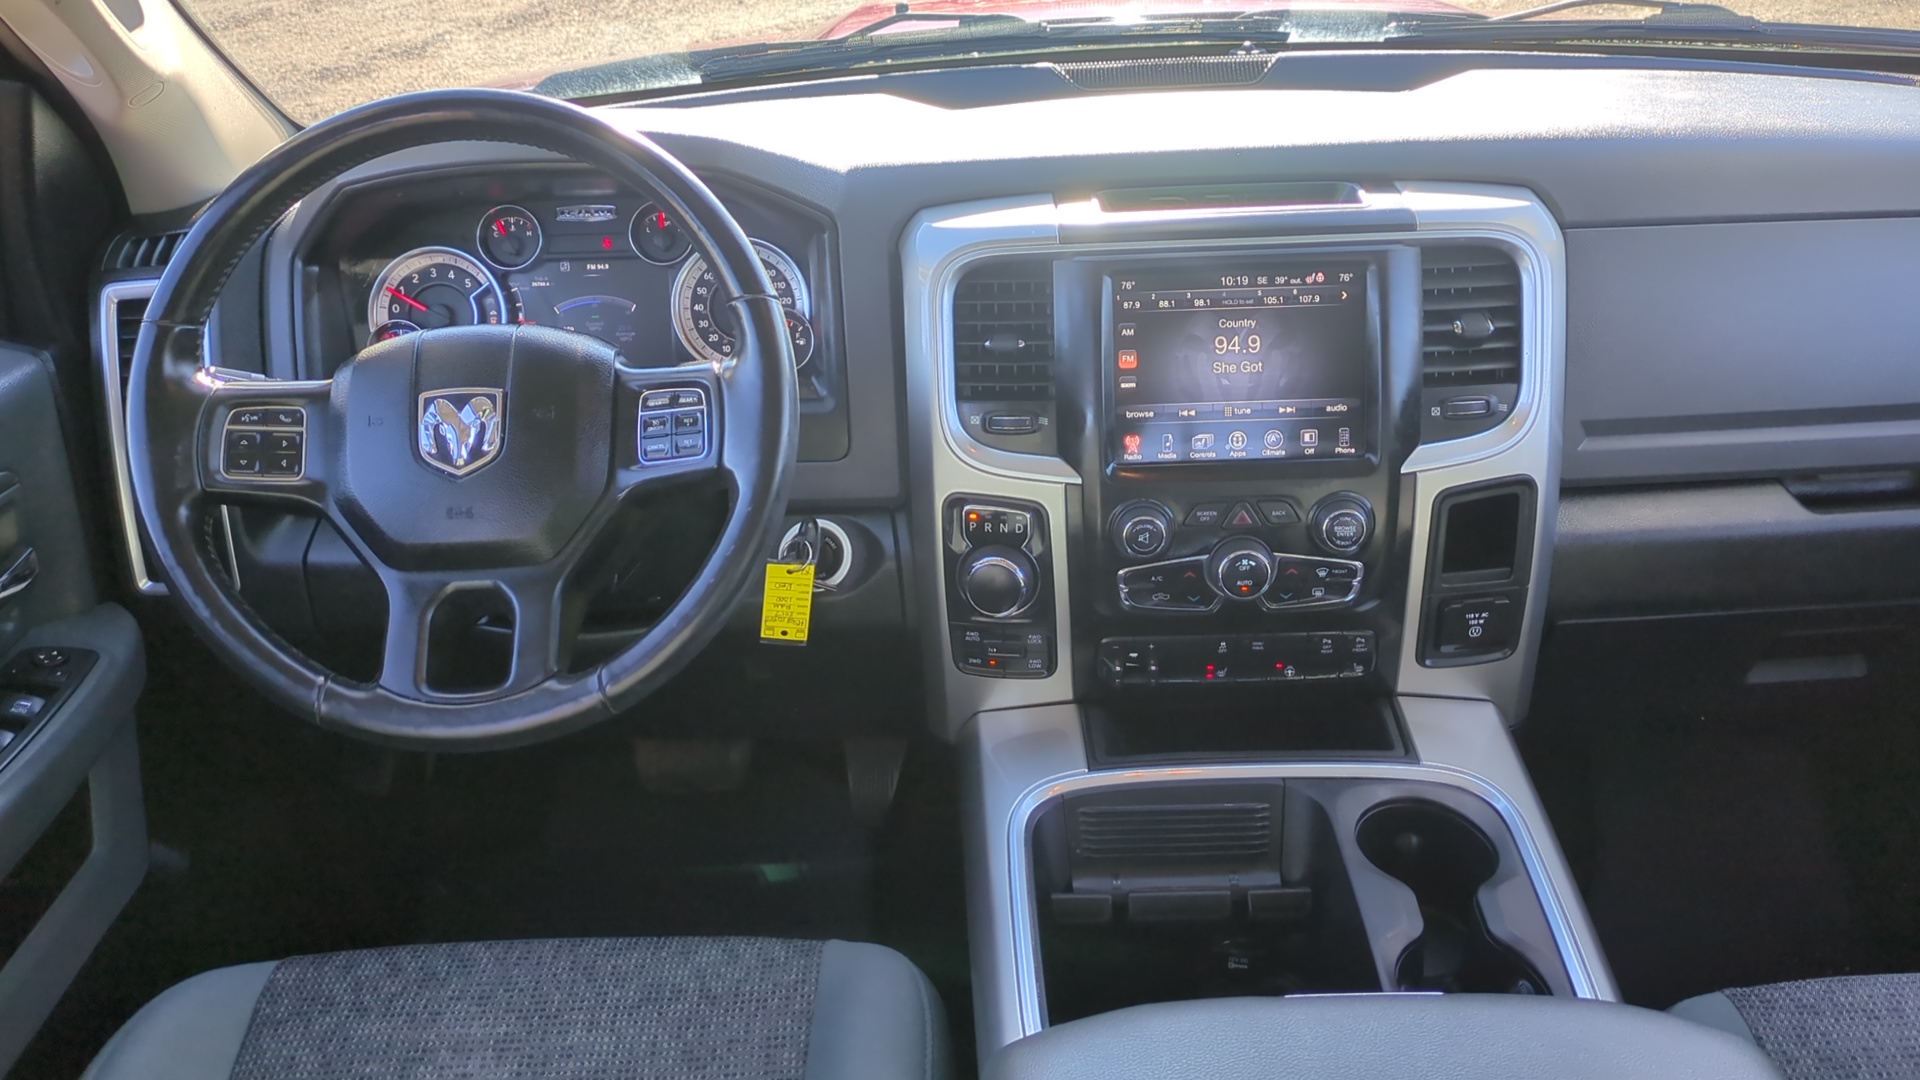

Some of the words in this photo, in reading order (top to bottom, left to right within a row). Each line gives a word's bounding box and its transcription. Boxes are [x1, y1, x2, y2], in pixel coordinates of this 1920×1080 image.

[430, 267, 437, 277] 3
[448, 270, 455, 279] 4
[703, 272, 714, 280] 60
[412, 273, 419, 283] 2
[1220, 275, 1249, 286] 10:19
[1257, 276, 1268, 285] SE
[465, 278, 472, 288] 5
[696, 287, 708, 295] 50
[1194, 299, 1211, 307] 98.1
[1263, 296, 1284, 304] 105.1
[1299, 295, 1320, 303] 107.9
[392, 304, 400, 313] 0
[693, 303, 704, 311] 40
[1123, 301, 1141, 309] 87.9
[1159, 300, 1175, 308] 88.1
[698, 320, 709, 328] 30
[1218, 318, 1257, 329] Country
[1121, 328, 1134, 336] AM
[708, 334, 719, 342] 20
[722, 345, 731, 353] 10
[1214, 334, 1261, 355] 94.9
[1212, 361, 1237, 374] She
[1240, 360, 1263, 373] Got
[1234, 407, 1252, 415] tune
[1325, 403, 1348, 412] audio
[1126, 410, 1155, 419] browse
[1229, 450, 1246, 458] Apps
[1335, 447, 1356, 455] Phone
[969, 521, 977, 532] P
[984, 522, 992, 533] R
[999, 522, 1008, 533] N
[1015, 523, 1024, 534] D
